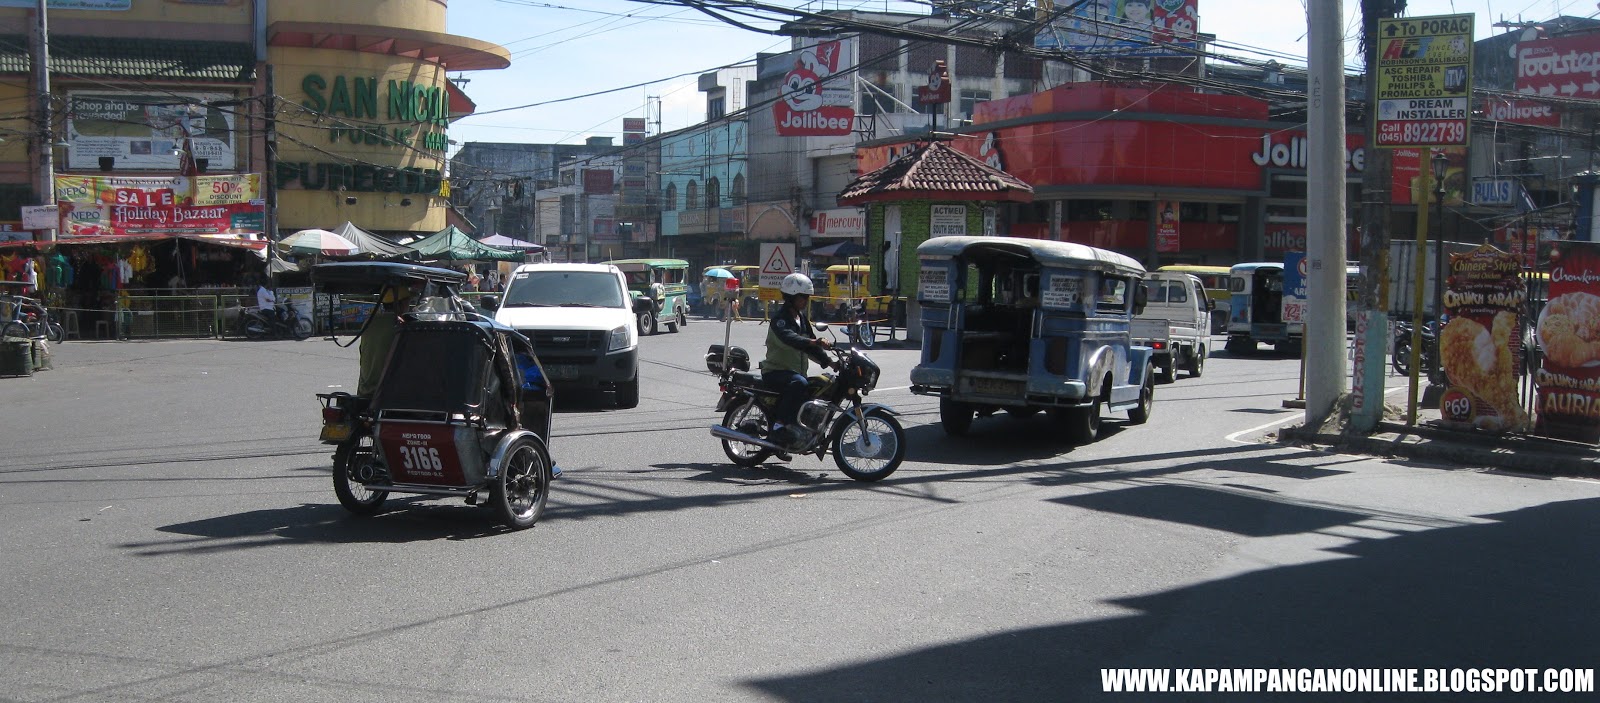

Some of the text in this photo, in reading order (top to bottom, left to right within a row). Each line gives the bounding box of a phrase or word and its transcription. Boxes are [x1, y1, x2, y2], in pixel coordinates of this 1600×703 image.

[1401, 18, 1469, 36] To PORAC
[1380, 56, 1468, 66] ROBINSON'S BALIBAGO
[1384, 66, 1441, 75] ASC REPAIR
[1391, 74, 1433, 82] TOSHIBA
[1447, 69, 1463, 87] TV
[1388, 82, 1426, 90] PHILIPS
[301, 73, 378, 120] SAN
[1381, 89, 1443, 98] PROMAC LCD
[75, 100, 103, 113] Shop
[1409, 99, 1453, 109] DREAM
[781, 110, 849, 130] Jollibee
[1397, 109, 1466, 120] INSTALLER
[1378, 122, 1465, 144] (045) 8922739
[1381, 123, 1400, 132] Call
[1396, 150, 1419, 158] Jollibee
[59, 186, 87, 197] NEPO
[212, 181, 243, 194] 50%
[71, 211, 100, 220] NEPO
[115, 205, 169, 223] Holiday
[173, 207, 228, 223] Bazaar
[826, 216, 862, 230] mercury
[932, 224, 964, 235] SOUTH SECTOR
[1443, 290, 1484, 308] CRUNCH
[1535, 368, 1578, 389] CRUNCH
[400, 446, 442, 470] 3166
